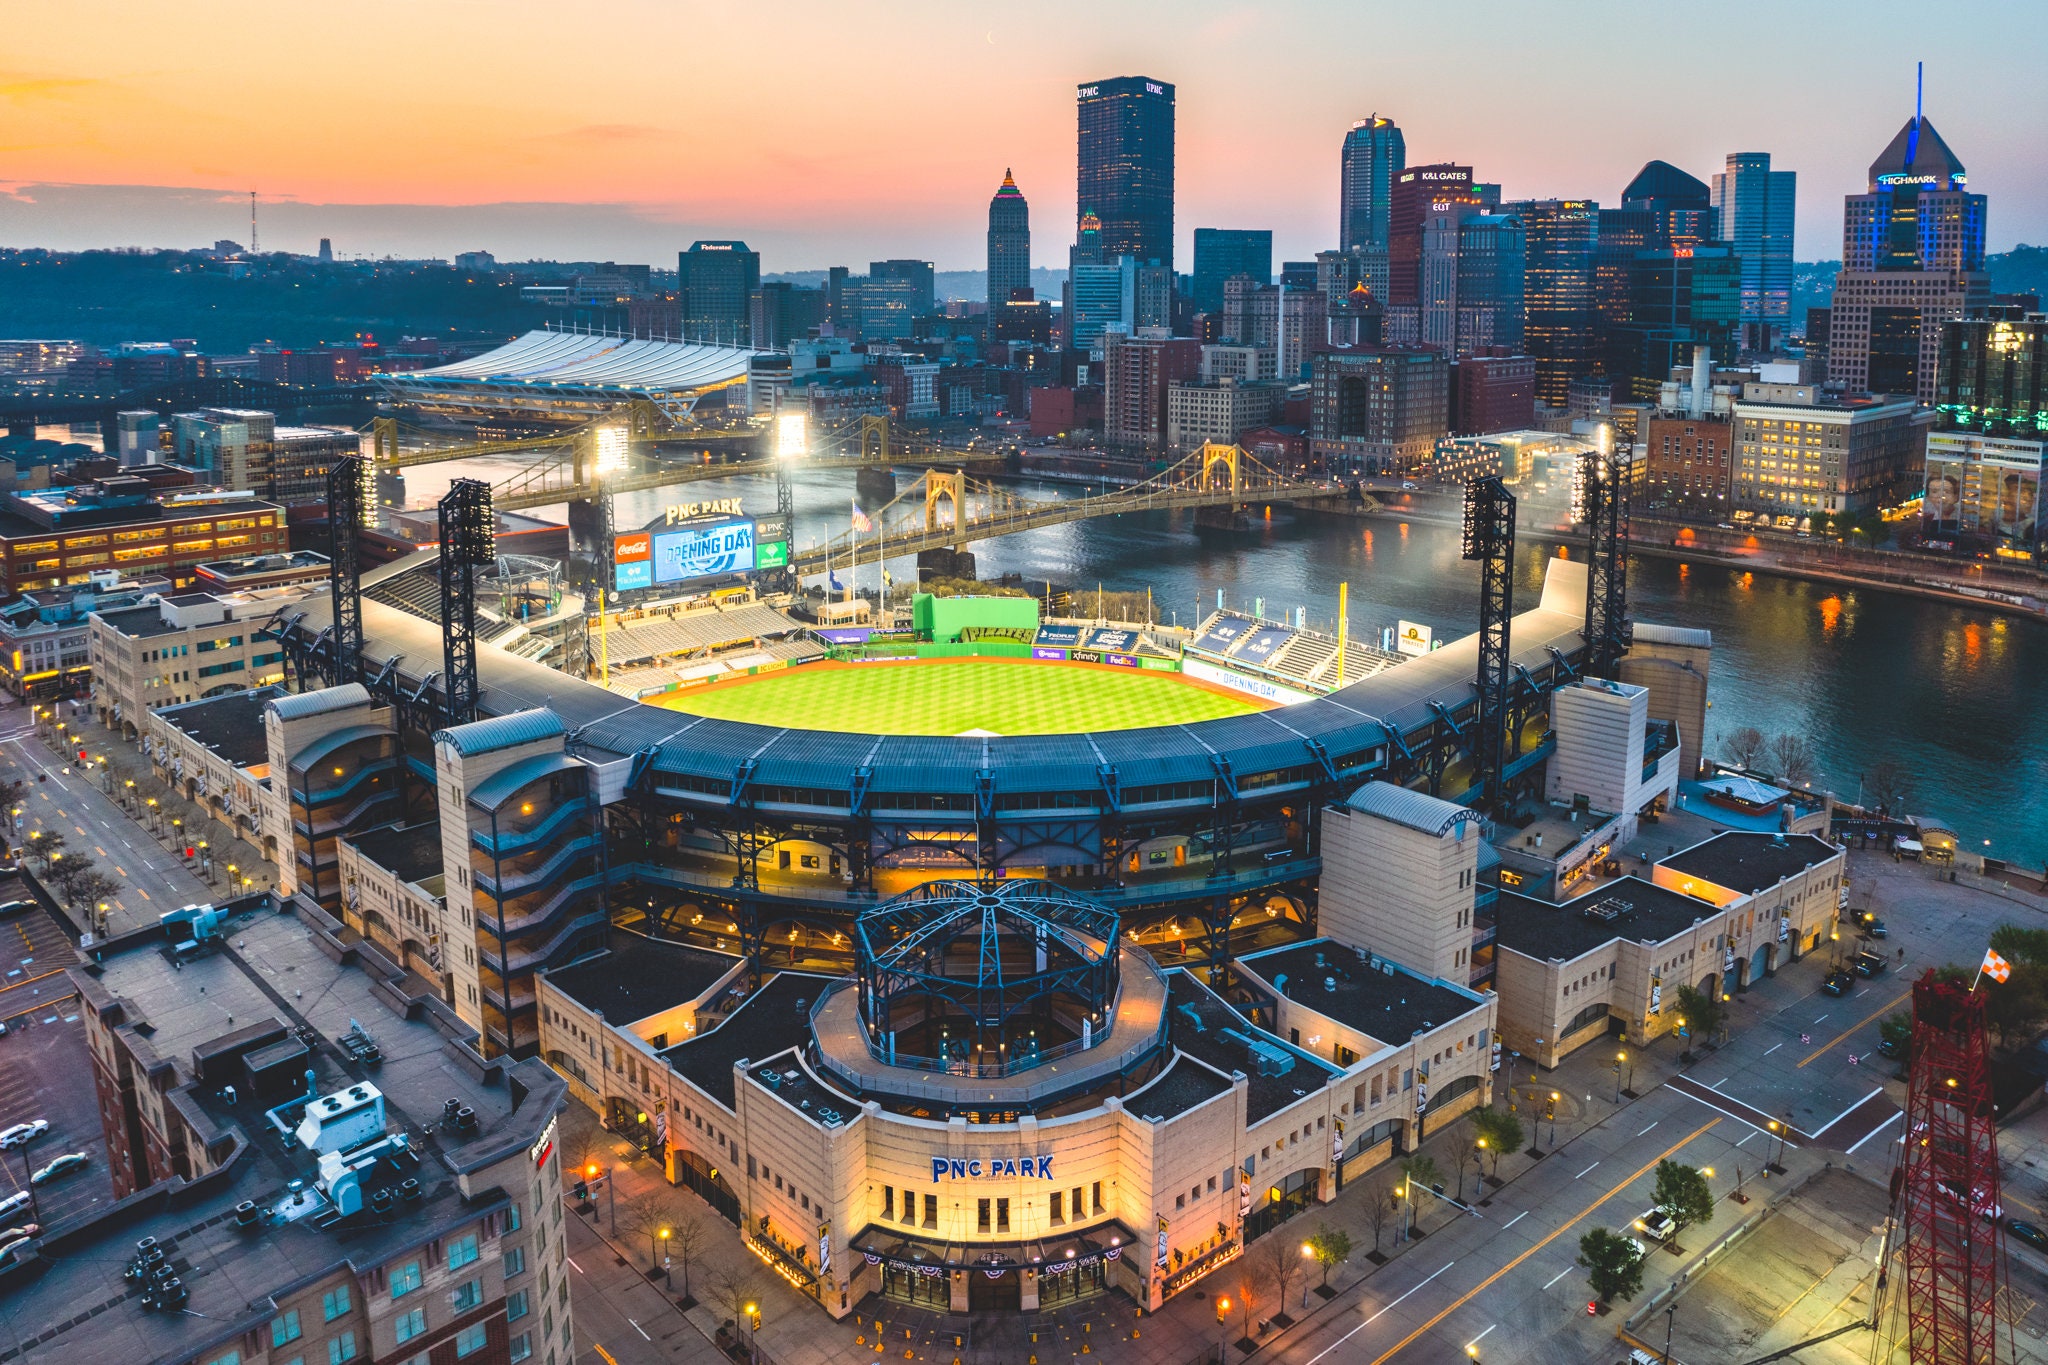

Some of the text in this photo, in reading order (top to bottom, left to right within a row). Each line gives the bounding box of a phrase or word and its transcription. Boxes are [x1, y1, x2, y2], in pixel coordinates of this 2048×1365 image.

[1077, 87, 1099, 98] UPMC
[1146, 83, 1163, 95] UPMC
[1422, 172, 1467, 180] K&L GATES
[1883, 175, 1937, 185] HIGHMARK
[1432, 202, 1451, 212] EQT
[666, 497, 744, 527] PNC PARK
[767, 522, 785, 532] PNC
[618, 541, 648, 556] Coca-Cola
[667, 537, 720, 563] OPENING
[725, 528, 752, 552] DAY
[968, 627, 1035, 645] PIRATES
[1247, 643, 1271, 655] AHN
[1072, 651, 1099, 662] xfinity
[1110, 655, 1133, 665] FedEx
[767, 661, 785, 671] LIGHT
[1223, 673, 1259, 693] OPENING
[1260, 684, 1277, 698] DAY
[931, 1153, 1055, 1184] PNC PARK
[1176, 1244, 1240, 1287] TICKET SALES
